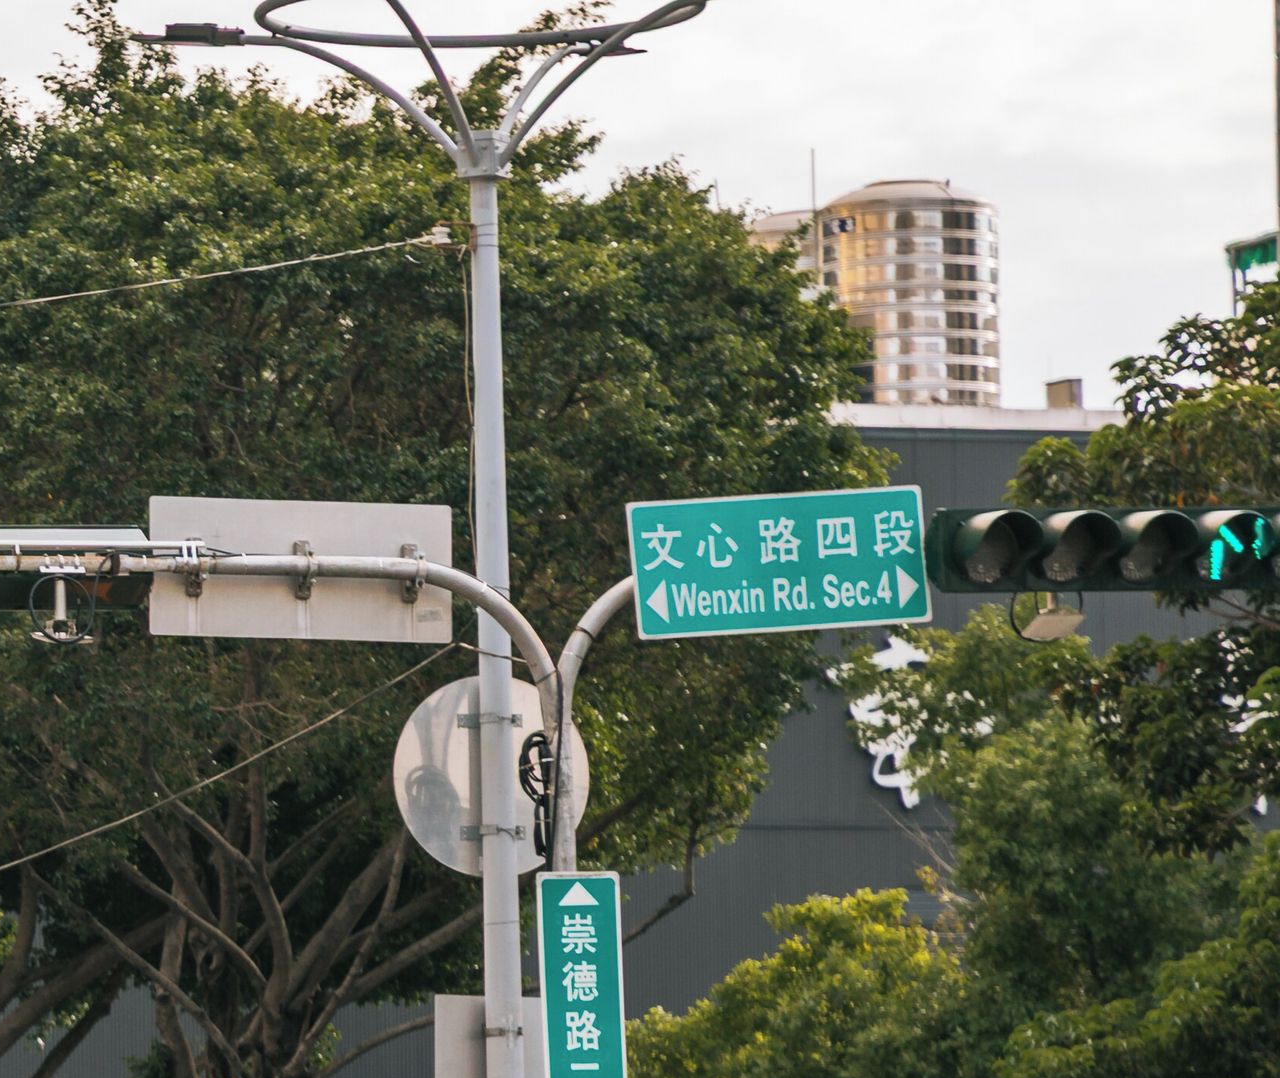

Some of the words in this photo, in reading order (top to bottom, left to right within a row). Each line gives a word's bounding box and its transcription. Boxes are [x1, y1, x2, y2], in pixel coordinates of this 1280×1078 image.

[641, 511, 915, 571] 文心路四段
[671, 580, 765, 617] Wenxin
[773, 577, 815, 611] Rd.
[823, 570, 892, 608] Sec.4
